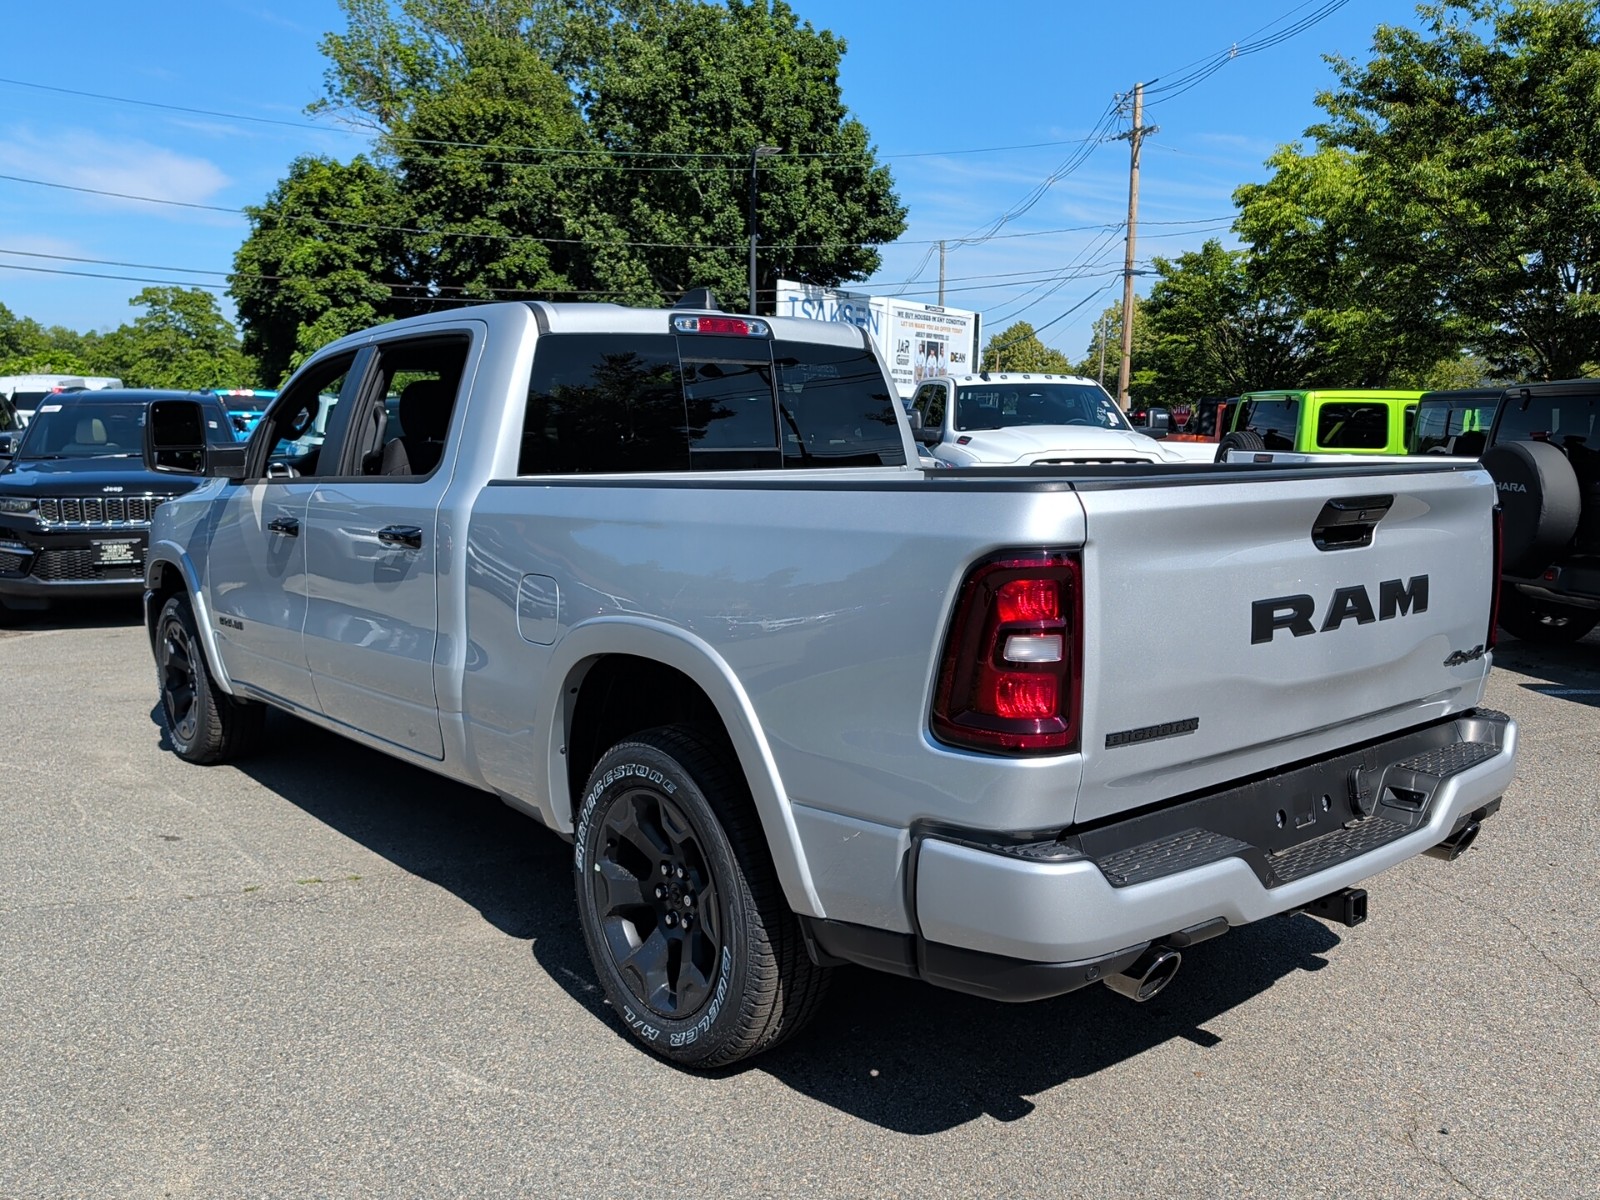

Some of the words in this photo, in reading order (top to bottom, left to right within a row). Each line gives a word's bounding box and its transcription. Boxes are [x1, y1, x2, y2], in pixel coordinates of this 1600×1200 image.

[914, 313, 931, 321] HOUSES
[946, 318, 966, 326] CONDITION
[914, 322, 926, 330] MAKE
[896, 339, 910, 354] JAR
[950, 352, 966, 363] DEAN
[1251, 574, 1429, 645] RAM
[575, 763, 678, 873] BRIDGESTONE
